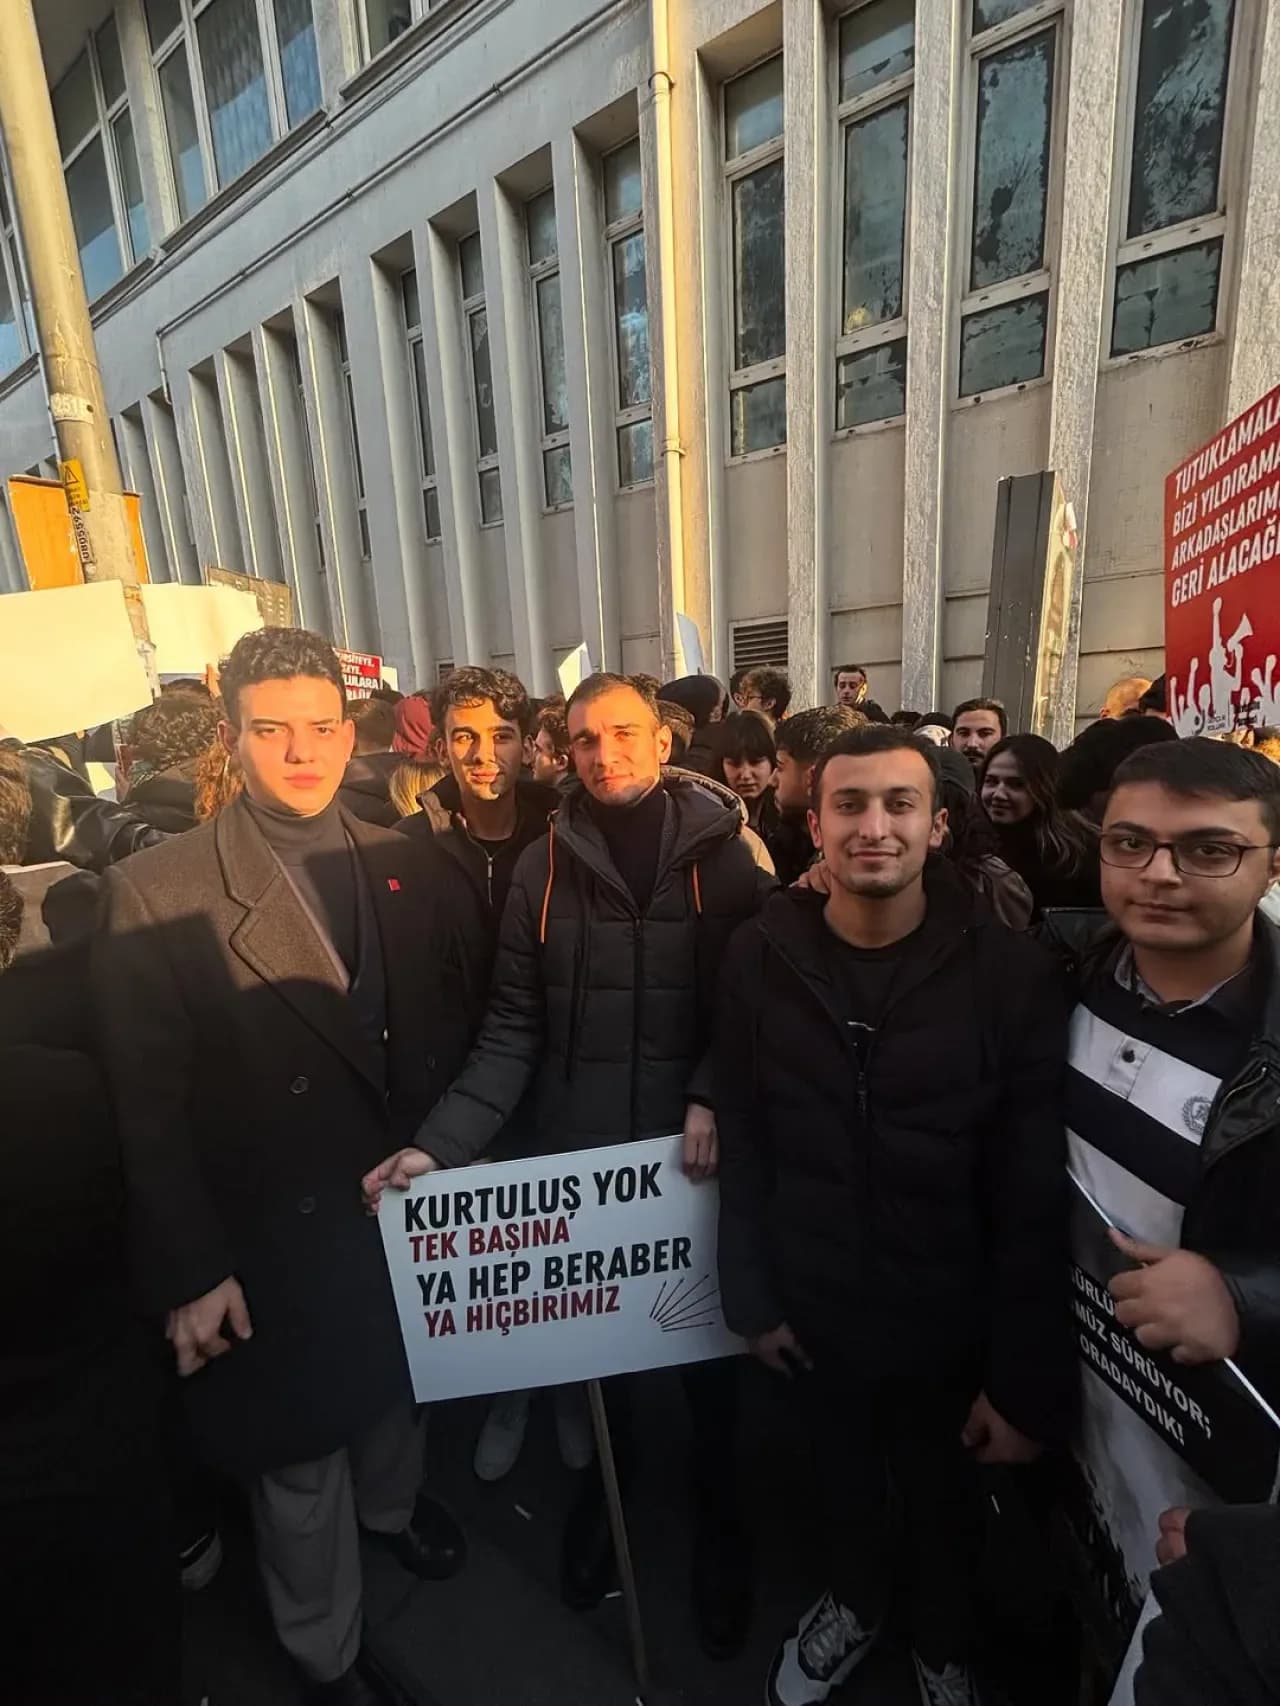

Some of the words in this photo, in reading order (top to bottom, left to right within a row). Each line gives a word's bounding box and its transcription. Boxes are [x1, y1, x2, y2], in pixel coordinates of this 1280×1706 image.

[1171, 480, 1280, 571] ARKADAŞLARIM
[1173, 492, 1198, 537] BİZİ
[1172, 558, 1204, 607] GERİ
[404, 1174, 582, 1232] KURTULUŞ
[593, 1161, 663, 1206] YOK
[409, 1231, 458, 1263] TEK
[469, 1216, 570, 1258] BAŞINA
[417, 1271, 456, 1306] YA
[469, 1260, 531, 1300] HEP
[543, 1237, 692, 1290] BERABER
[1072, 1266, 1114, 1316] ÜRLÜ
[424, 1309, 456, 1338] YA
[466, 1284, 620, 1336] HİÇBİRİMİZ
[1074, 1299, 1108, 1342] MÜZ
[1110, 1332, 1211, 1439] SÜRÜYOR;
[1080, 1334, 1184, 1446] ORADAYDIK!
